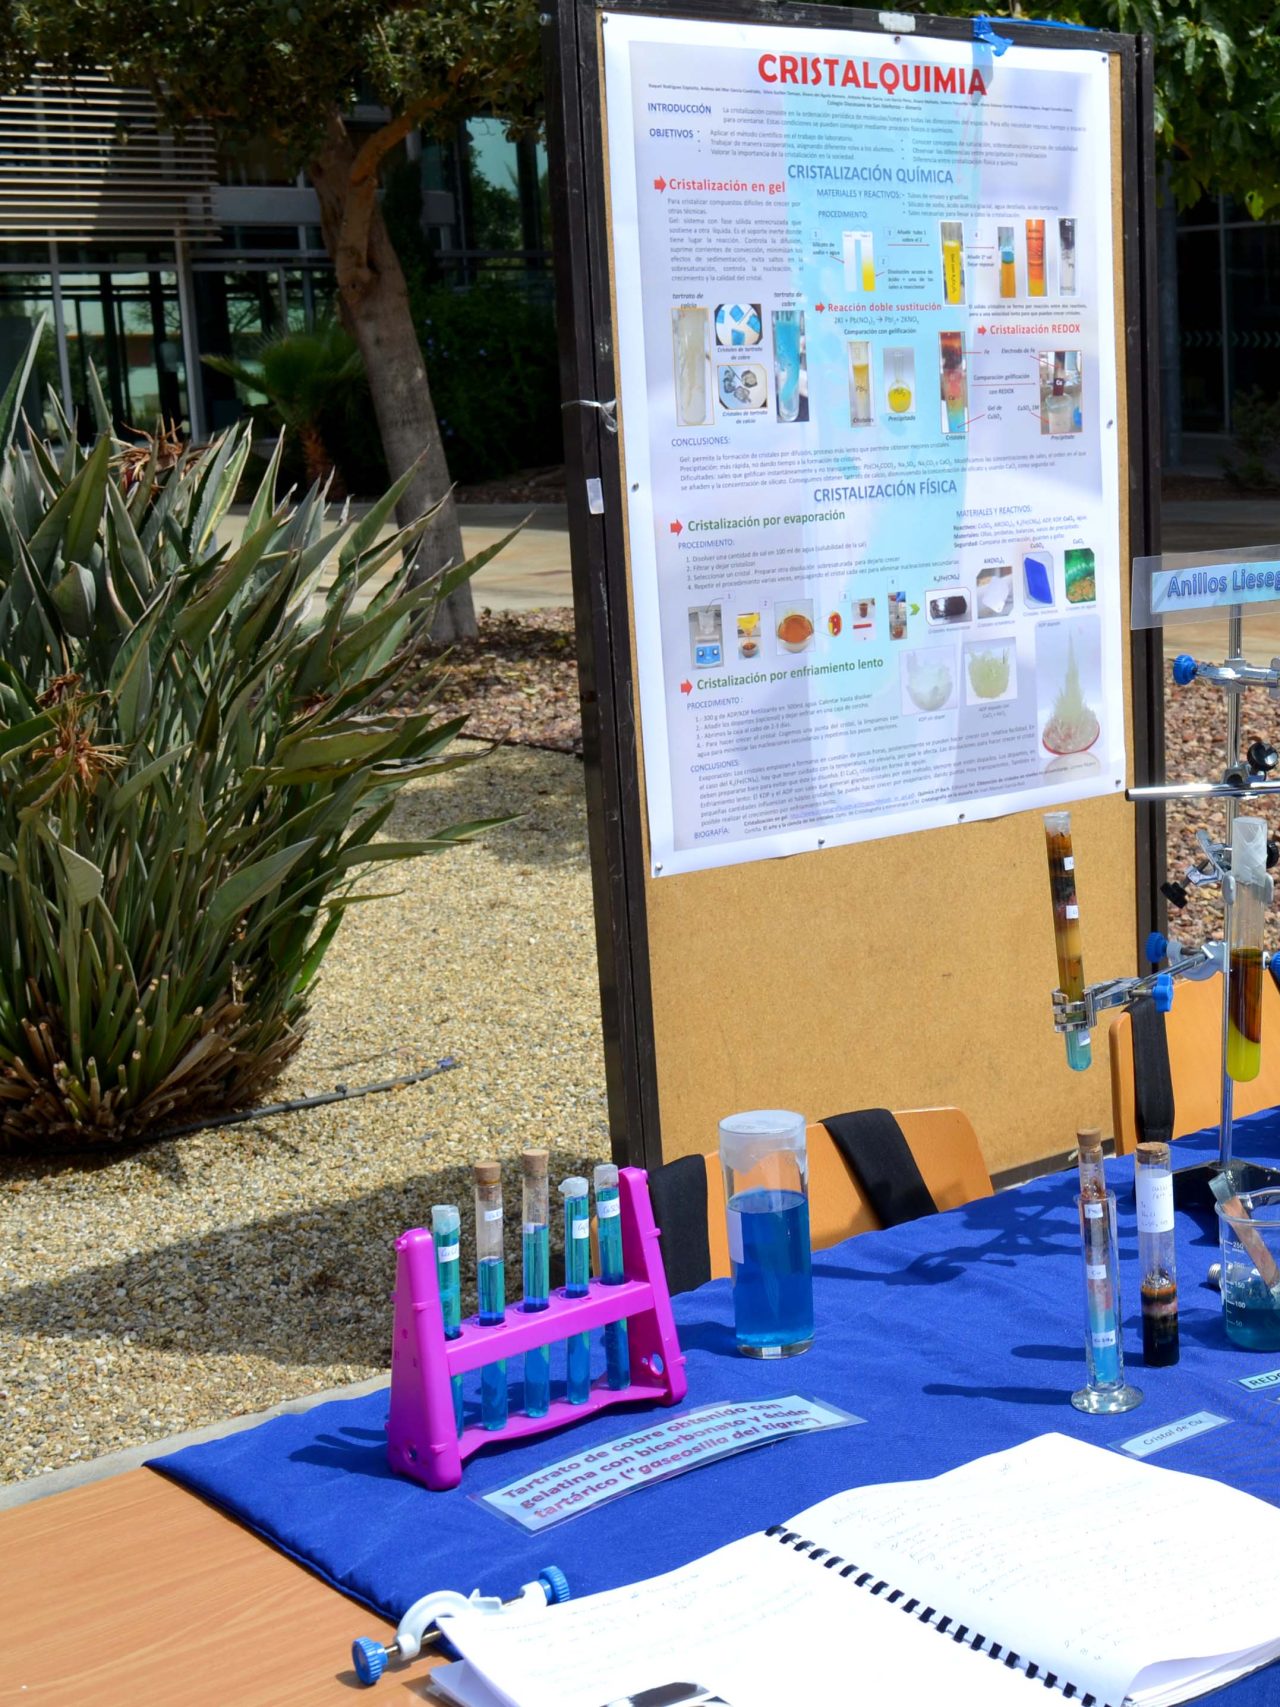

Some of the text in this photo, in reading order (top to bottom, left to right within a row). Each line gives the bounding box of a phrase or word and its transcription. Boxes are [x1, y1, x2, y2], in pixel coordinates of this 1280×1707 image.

[758, 54, 987, 96] CRISTALQUIMIA
[648, 103, 711, 114] INTRODUCCIÓN
[649, 129, 694, 138] OBJETIVOS
[788, 164, 954, 184] CRISTALIZACIÓN QUÍMICA
[669, 178, 785, 195] Cristalización en gel
[817, 189, 857, 198] MATERIALES
[828, 303, 941, 312] Reacción doble sustitución
[990, 324, 1080, 334] Cristalización REDOX
[671, 436, 731, 447] CONCLUSIONES:
[814, 482, 915, 504] CRISTALIZACIÓN
[919, 479, 957, 496] FÍSICA
[688, 510, 845, 531] Cristalización por evaporación
[678, 538, 735, 549] PROCEDIMIENTO:
[1168, 573, 1227, 597] Anillos
[697, 658, 883, 690] Cristalización por enfriamiento lento
[687, 697, 740, 709] PROCEDIMIENTO
[1144, 1430, 1174, 1445] Cristal
[1188, 1419, 1203, 1427] Cu
[503, 1403, 782, 1499] Tartrato de cobre obtenido con
[520, 1470, 597, 1509] gelatina
[600, 1456, 635, 1472] con
[635, 1419, 746, 1457] bicarbonato
[534, 1477, 618, 1518] tartárico
[732, 1426, 760, 1440] del
